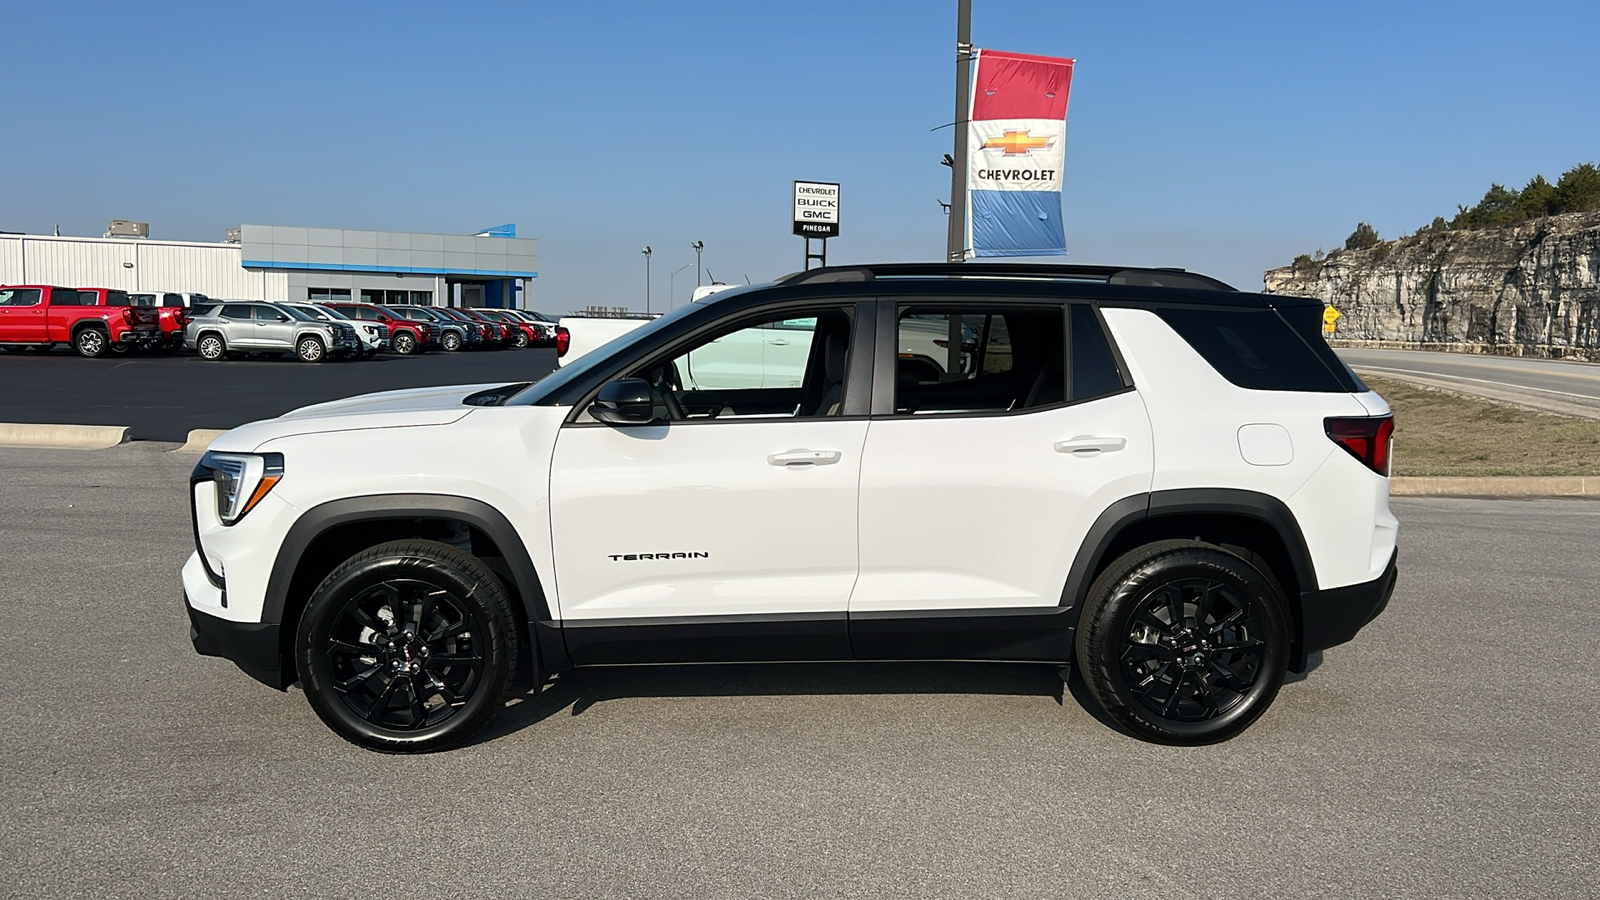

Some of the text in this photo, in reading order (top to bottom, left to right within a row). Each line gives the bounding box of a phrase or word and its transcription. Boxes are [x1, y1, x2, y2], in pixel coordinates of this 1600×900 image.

[977, 168, 1055, 181] CHEVROLET
[798, 186, 836, 196] CHEVROLET
[797, 198, 836, 208] BUICK
[802, 210, 831, 219] GMC
[802, 224, 831, 232] PINEGAR
[608, 552, 709, 561] TERRAIN
